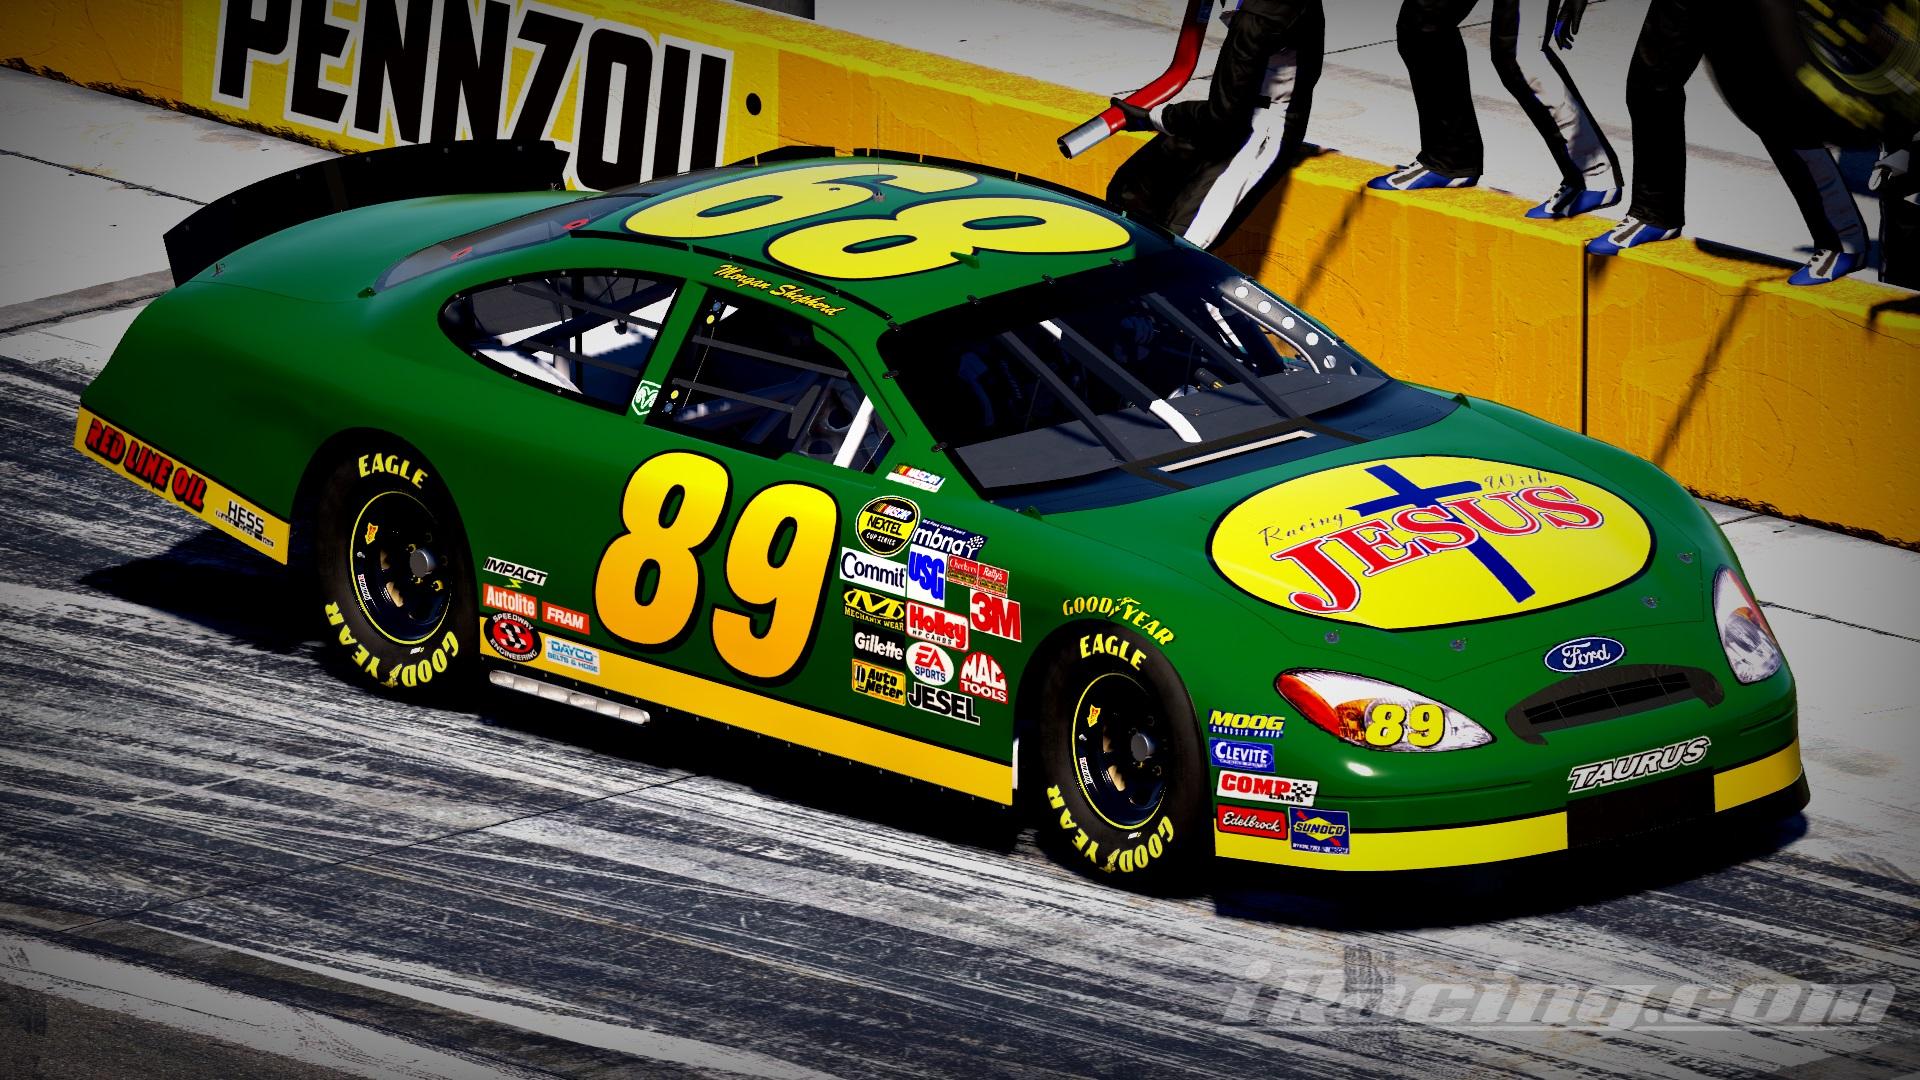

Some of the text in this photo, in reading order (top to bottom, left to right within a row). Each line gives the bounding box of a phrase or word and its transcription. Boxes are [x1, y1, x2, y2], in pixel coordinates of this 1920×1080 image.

[714, 264, 846, 316] Morgan Shepherd
[85, 417, 208, 514] RED LINE OIL
[358, 453, 429, 490] EAGLE
[228, 500, 265, 534] HESS
[1258, 472, 1549, 546] Racing With
[867, 515, 903, 536] NEXTEL
[912, 527, 967, 556] mbna
[1271, 485, 1604, 613] JESUS
[483, 558, 547, 585] IMPACT
[594, 450, 839, 681] 89
[841, 551, 905, 589] Commit
[908, 551, 945, 600] USG
[983, 566, 1003, 581] Rally's
[486, 586, 536, 617] Autolite
[492, 612, 534, 631] SPEEDWAY
[546, 606, 584, 630] FRAM
[845, 605, 904, 632] MECHANIX WEAR
[909, 604, 967, 649] Holley
[970, 592, 1021, 641] 3M
[489, 637, 539, 662] ENGINEERING
[550, 640, 595, 662] DAYCO
[854, 632, 904, 660] Gillette
[914, 645, 946, 672] EA
[1079, 633, 1148, 672] EAGLE
[1561, 642, 1611, 669] Ford
[867, 667, 898, 687] Auto
[914, 665, 946, 683] SPORTS
[961, 653, 1007, 691] MAC
[865, 678, 904, 699] Meter
[961, 679, 1007, 703] TOOLS
[907, 682, 980, 724] JESEL
[1209, 710, 1285, 731] MOOG
[1253, 729, 1281, 739] PARTS
[1365, 703, 1446, 748] 89
[1215, 741, 1269, 764] CLEVITE
[1568, 736, 1711, 794] TAURUS
[1221, 773, 1292, 797] COMP
[1222, 811, 1281, 833] Edelbrock
[1294, 822, 1345, 836] SUNOCO
